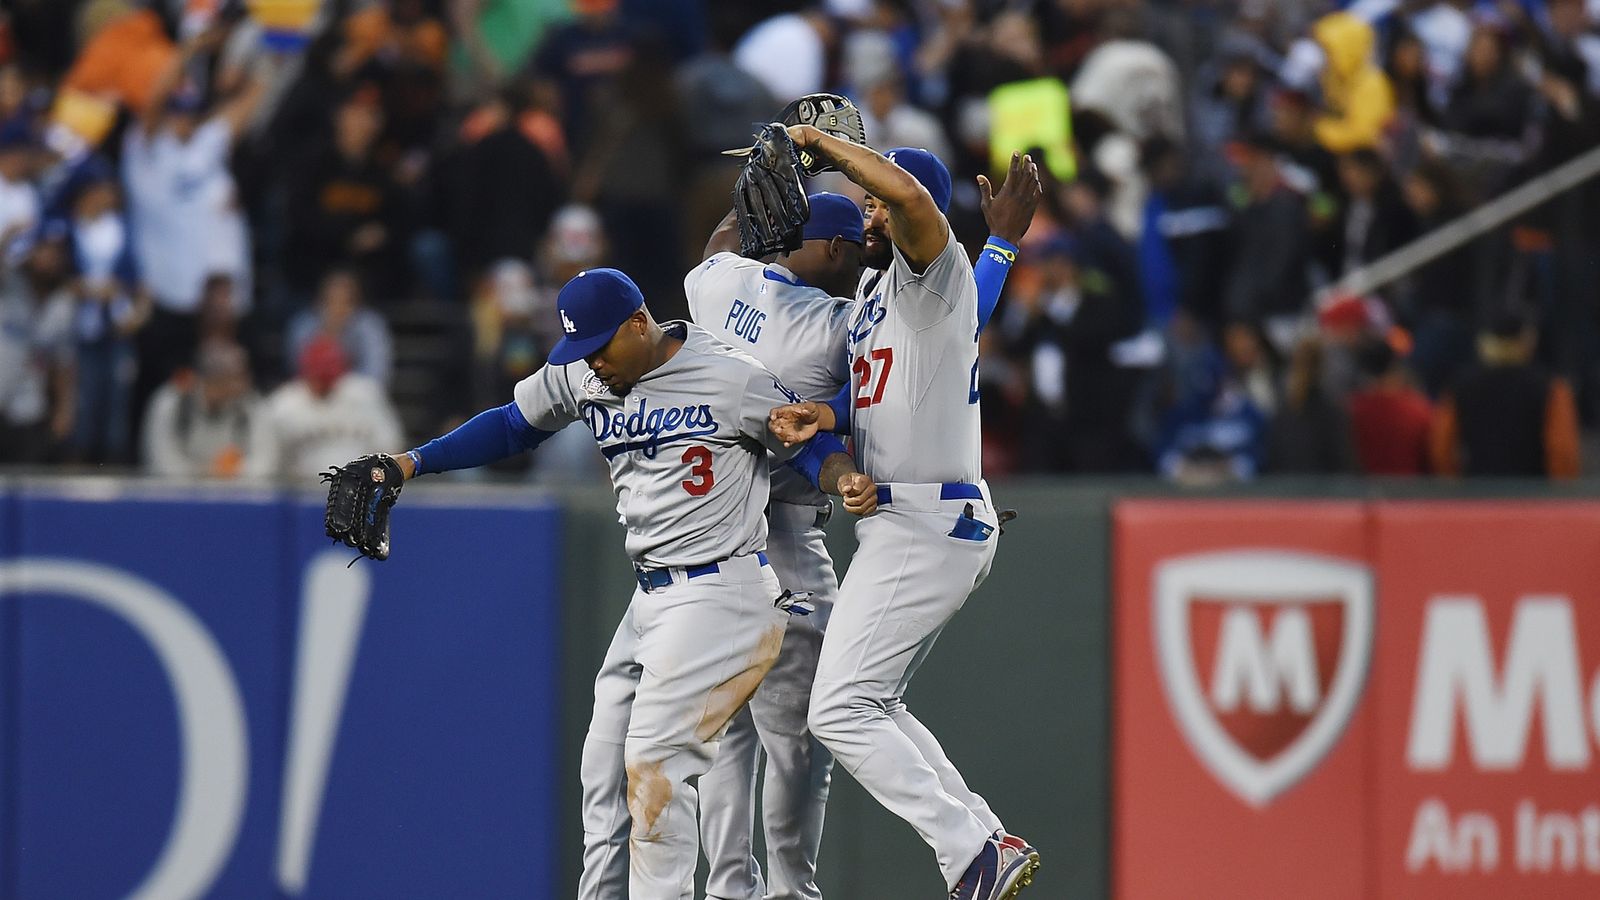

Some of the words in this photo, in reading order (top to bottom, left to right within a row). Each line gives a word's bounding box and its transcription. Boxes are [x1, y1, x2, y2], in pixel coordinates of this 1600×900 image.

[560, 309, 577, 333] LA
[724, 298, 767, 344] PUIG
[852, 346, 895, 410] 27
[583, 397, 719, 462] Dodgers
[681, 445, 715, 497] 3
[1405, 594, 1600, 771] M
[1405, 799, 1500, 873] An
